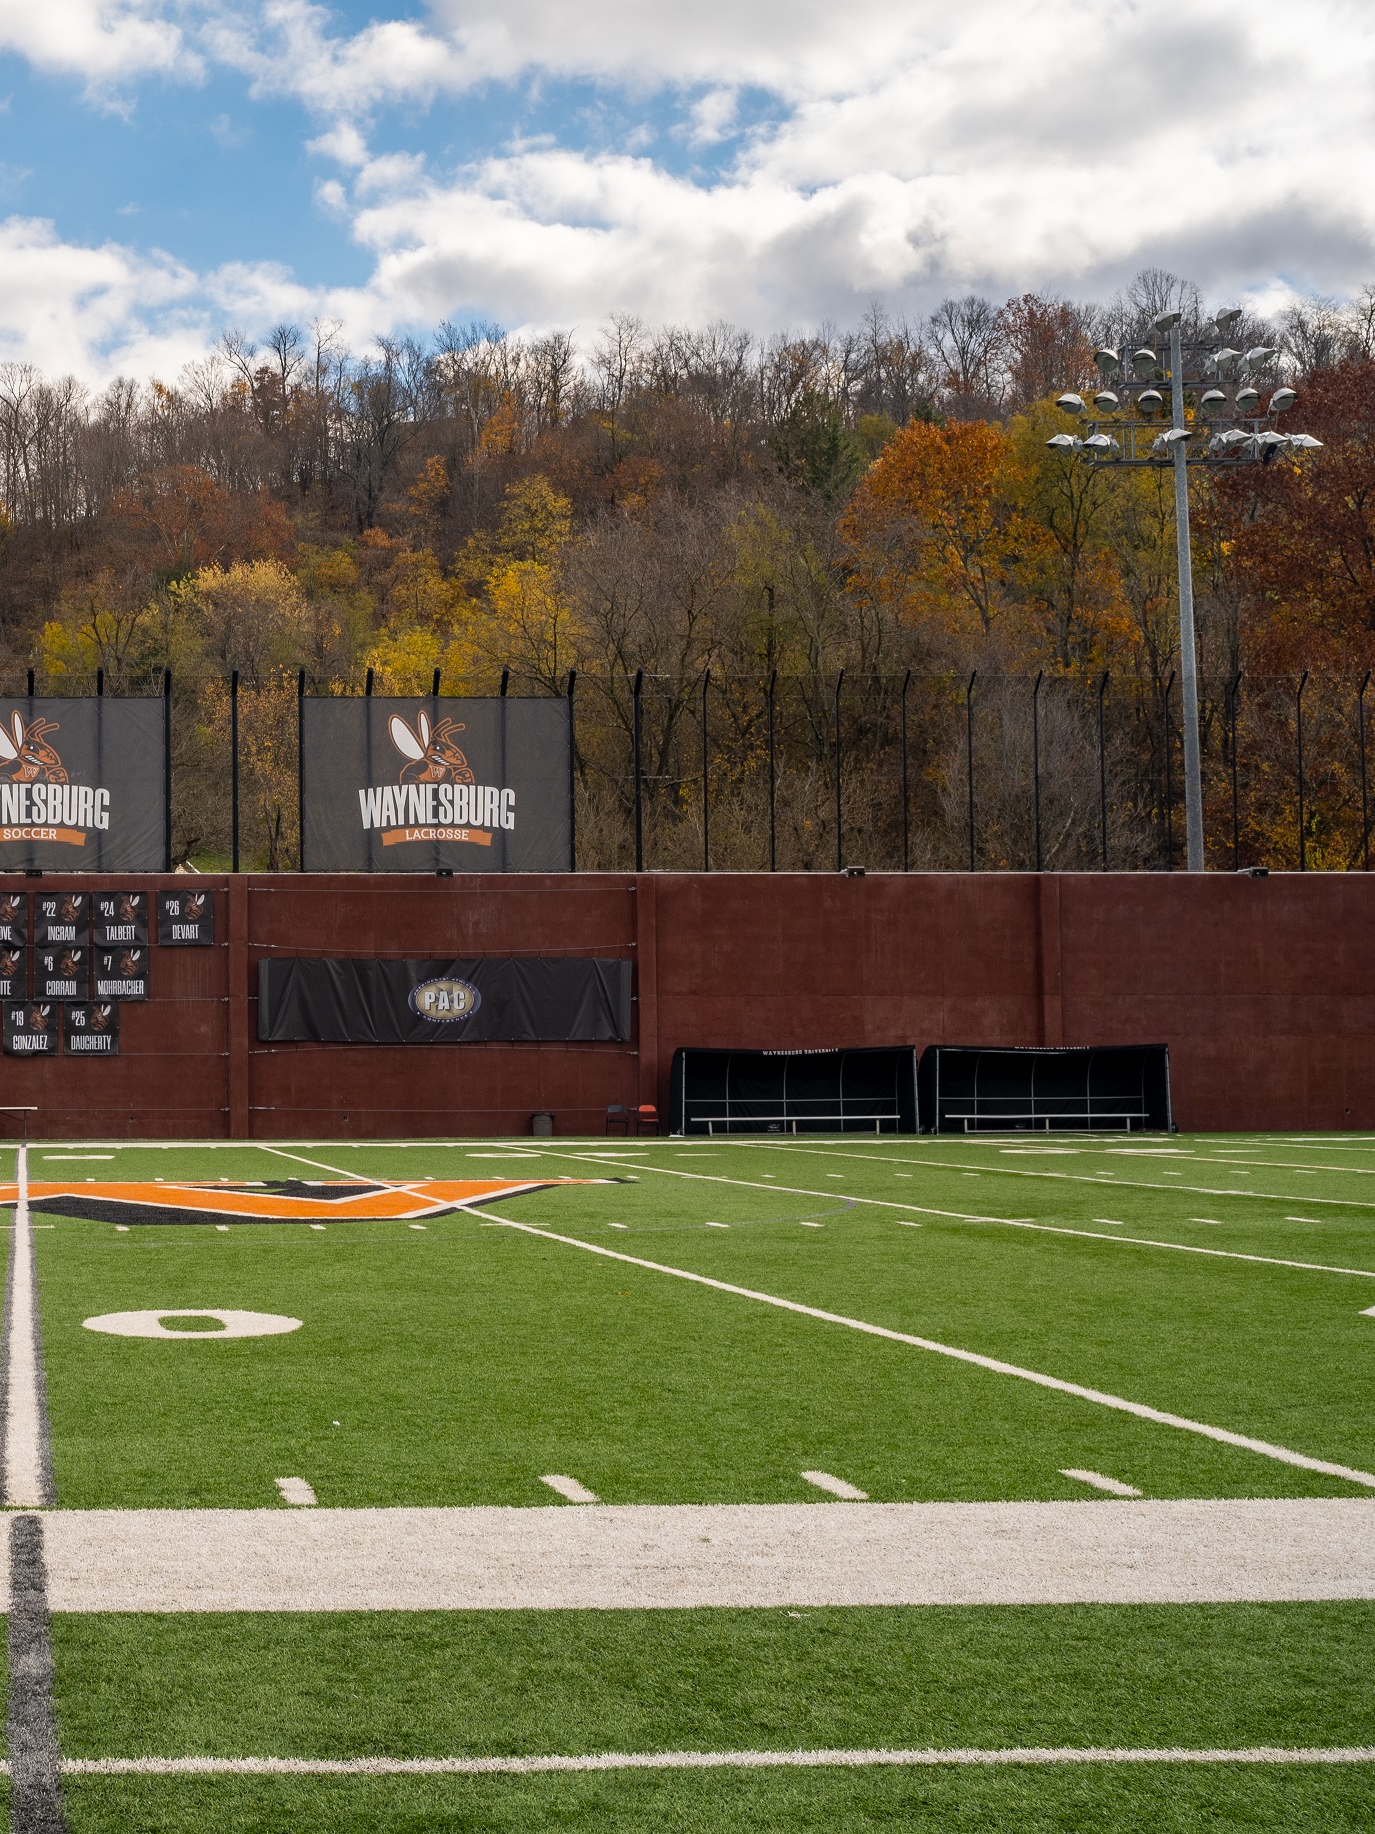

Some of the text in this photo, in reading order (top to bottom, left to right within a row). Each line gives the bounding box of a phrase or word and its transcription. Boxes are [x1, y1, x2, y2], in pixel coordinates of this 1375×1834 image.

[358, 783, 516, 830] WAYNESBURG
[2, 828, 57, 840] SOCCER
[405, 829, 470, 841] LACROSSE
[42, 901, 56, 917] #22
[100, 901, 114, 917] #24
[165, 900, 179, 916] #26
[47, 926, 76, 941] INGRAM
[105, 925, 136, 941] TALBERT
[172, 924, 199, 940] DEVART
[44, 956, 54, 972] #6
[103, 955, 112, 971] #7
[46, 980, 77, 996] CORRADI
[97, 980, 144, 995] MOHRBACHER
[424, 990, 465, 1010] PAC
[11, 1010, 24, 1026] #19
[71, 1010, 85, 1026] #25
[12, 1035, 48, 1050] GONZALEZ
[70, 1035, 112, 1050] DAUGHERTY
